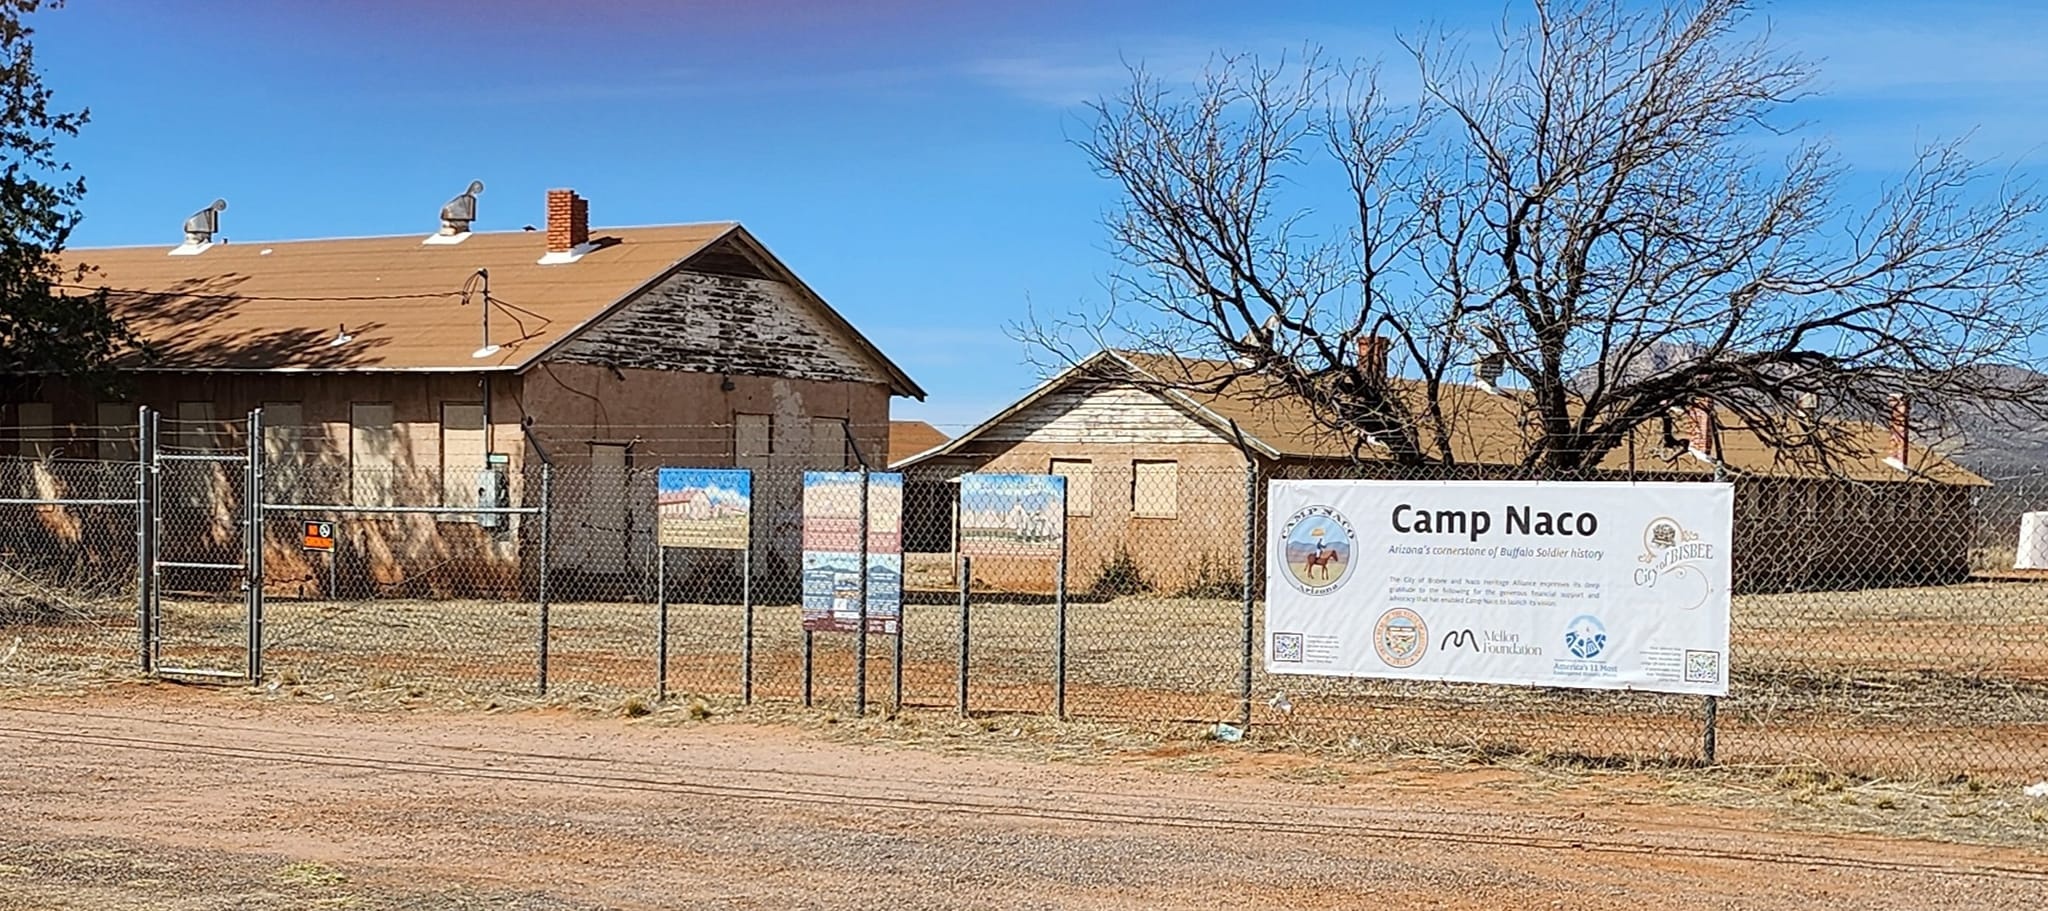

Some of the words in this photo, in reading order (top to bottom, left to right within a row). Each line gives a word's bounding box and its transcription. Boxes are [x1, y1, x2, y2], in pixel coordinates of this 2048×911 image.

[1281, 507, 1318, 540] CAMP
[1322, 508, 1355, 540] NACO
[1392, 504, 1491, 542] Camp
[1506, 505, 1598, 537] Naco
[1388, 545, 1430, 555] Arizona's
[1432, 546, 1486, 556] cornerstone
[1488, 546, 1499, 559] of
[1500, 547, 1534, 559] Buffalo
[1536, 548, 1569, 558] Soldier
[1571, 549, 1604, 561] history
[1671, 543, 1714, 565] BISBEE
[1297, 584, 1338, 594] Arizona
[1483, 630, 1519, 642] Mellon
[1483, 643, 1543, 656] Foundation
[1553, 663, 1589, 671] America's
